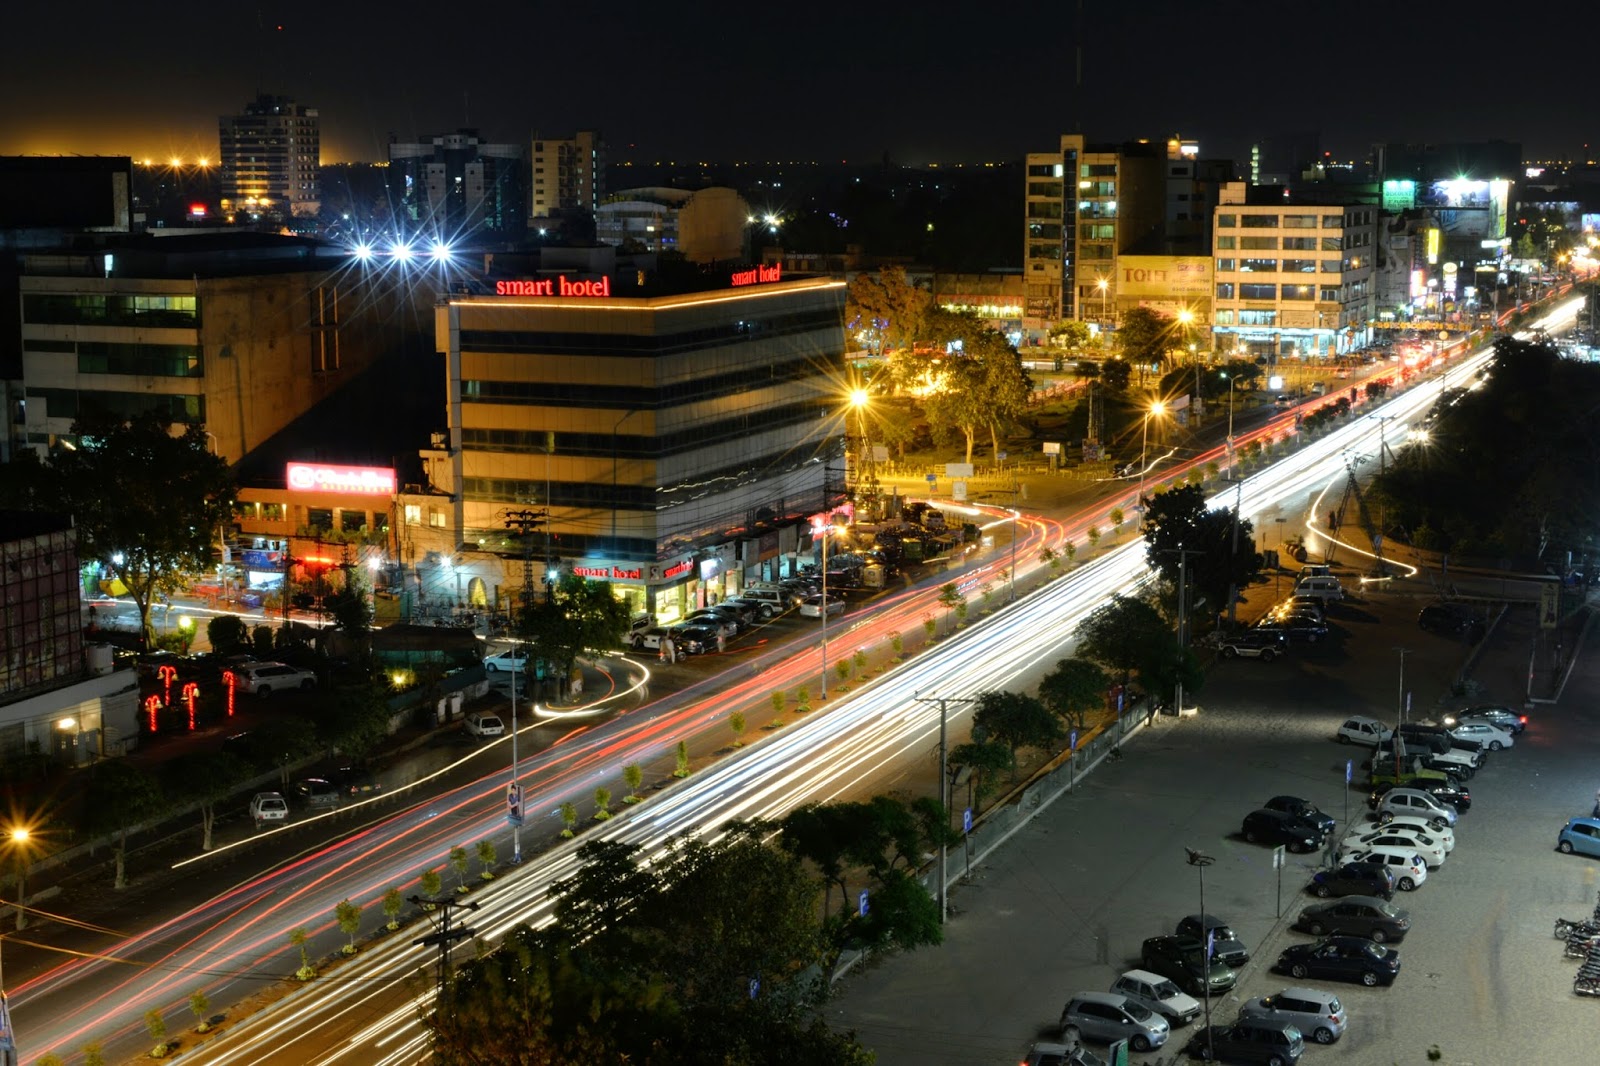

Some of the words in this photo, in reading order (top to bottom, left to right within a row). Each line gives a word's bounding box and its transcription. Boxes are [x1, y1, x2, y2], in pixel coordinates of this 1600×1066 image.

[731, 269, 757, 286] smart
[759, 262, 781, 283] hotel
[496, 279, 554, 296] smart
[559, 274, 610, 297] hotel
[573, 566, 609, 577] smart
[611, 565, 642, 580] hotel
[664, 563, 682, 579] smart
[680, 557, 694, 573] hotel
[964, 810, 971, 830] P
[860, 892, 867, 915] P
